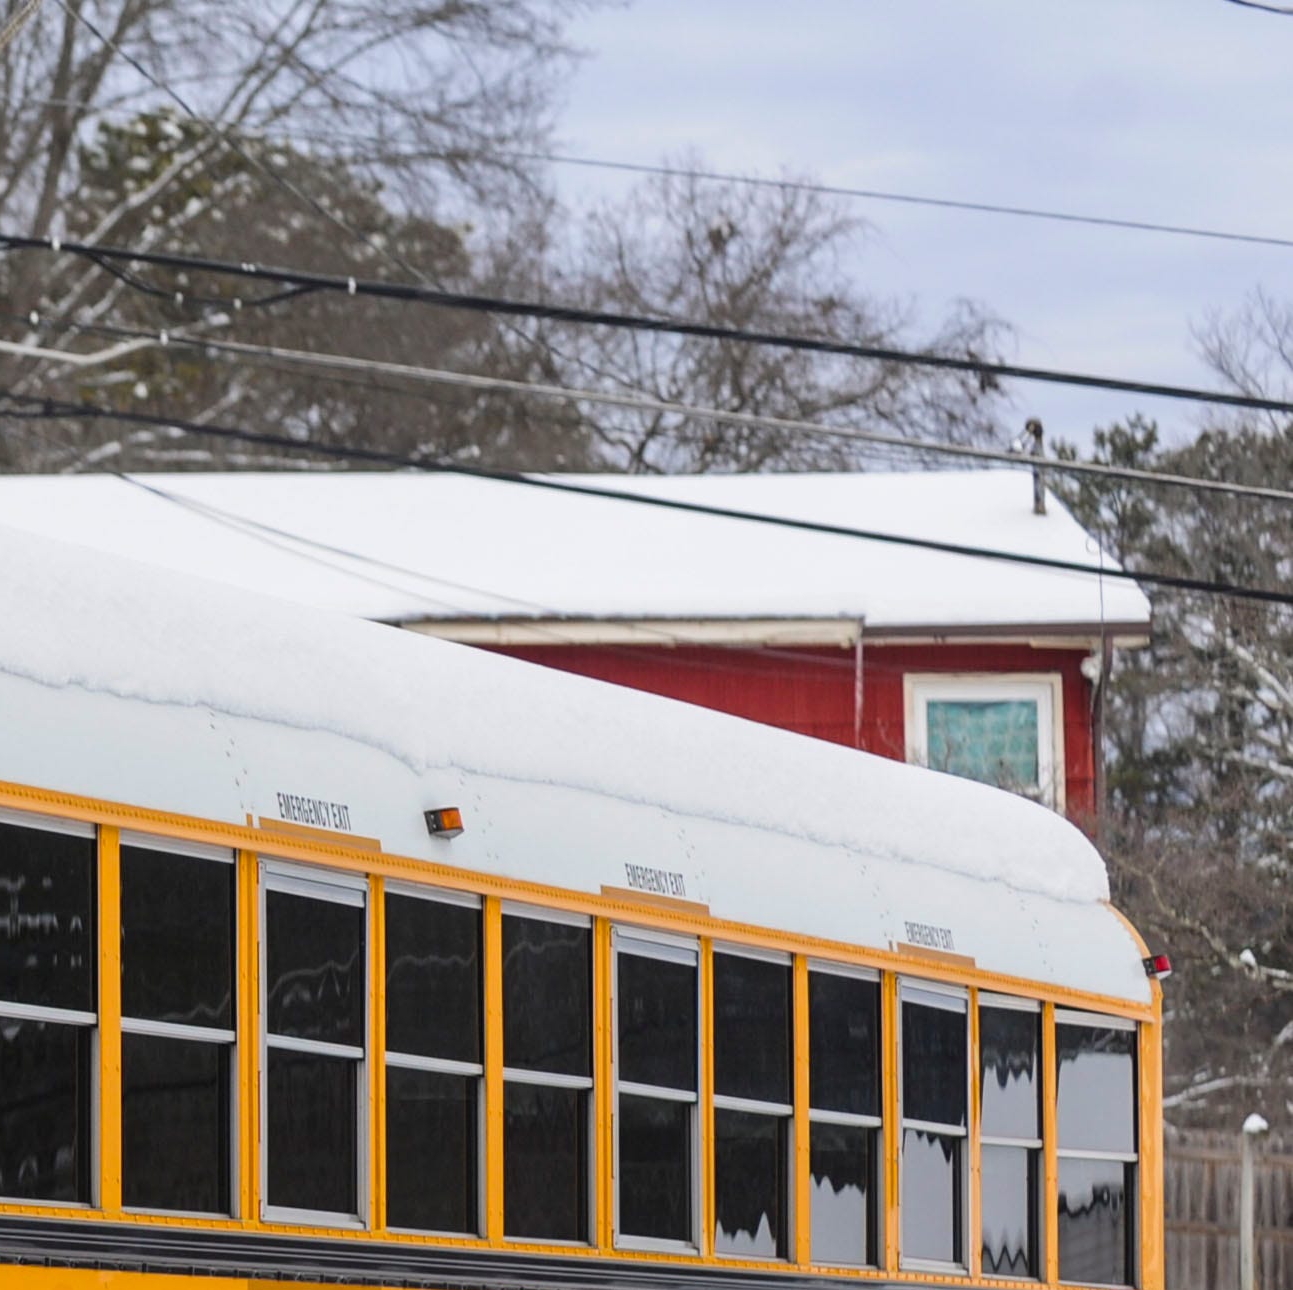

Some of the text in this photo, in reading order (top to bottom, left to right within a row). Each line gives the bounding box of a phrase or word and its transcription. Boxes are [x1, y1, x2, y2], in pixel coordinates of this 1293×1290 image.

[276, 792, 352, 831] EMERGENCY EXIT
[624, 863, 687, 896] EMERGENCY EXIT
[904, 921, 955, 950] EMERGENCY EXIT
